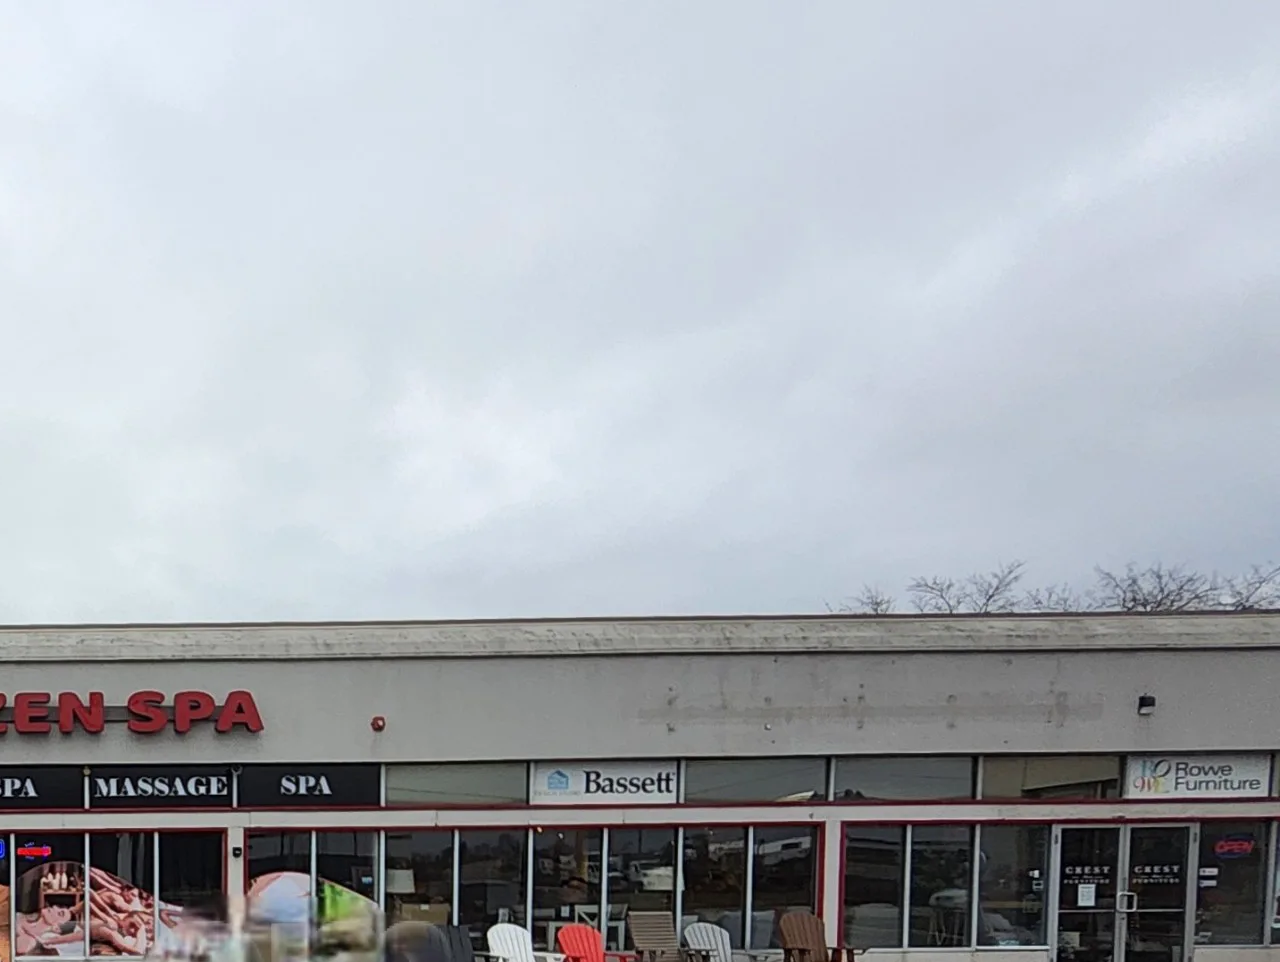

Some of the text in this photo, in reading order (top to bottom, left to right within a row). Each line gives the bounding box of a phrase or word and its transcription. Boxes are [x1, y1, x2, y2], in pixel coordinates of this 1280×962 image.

[127, 690, 265, 734] SPA
[1175, 762, 1233, 777] Rowe
[94, 776, 228, 797] MASSAGE
[280, 775, 333, 796] SPA
[583, 770, 675, 794] Bassett
[1174, 776, 1262, 791] Furniture
